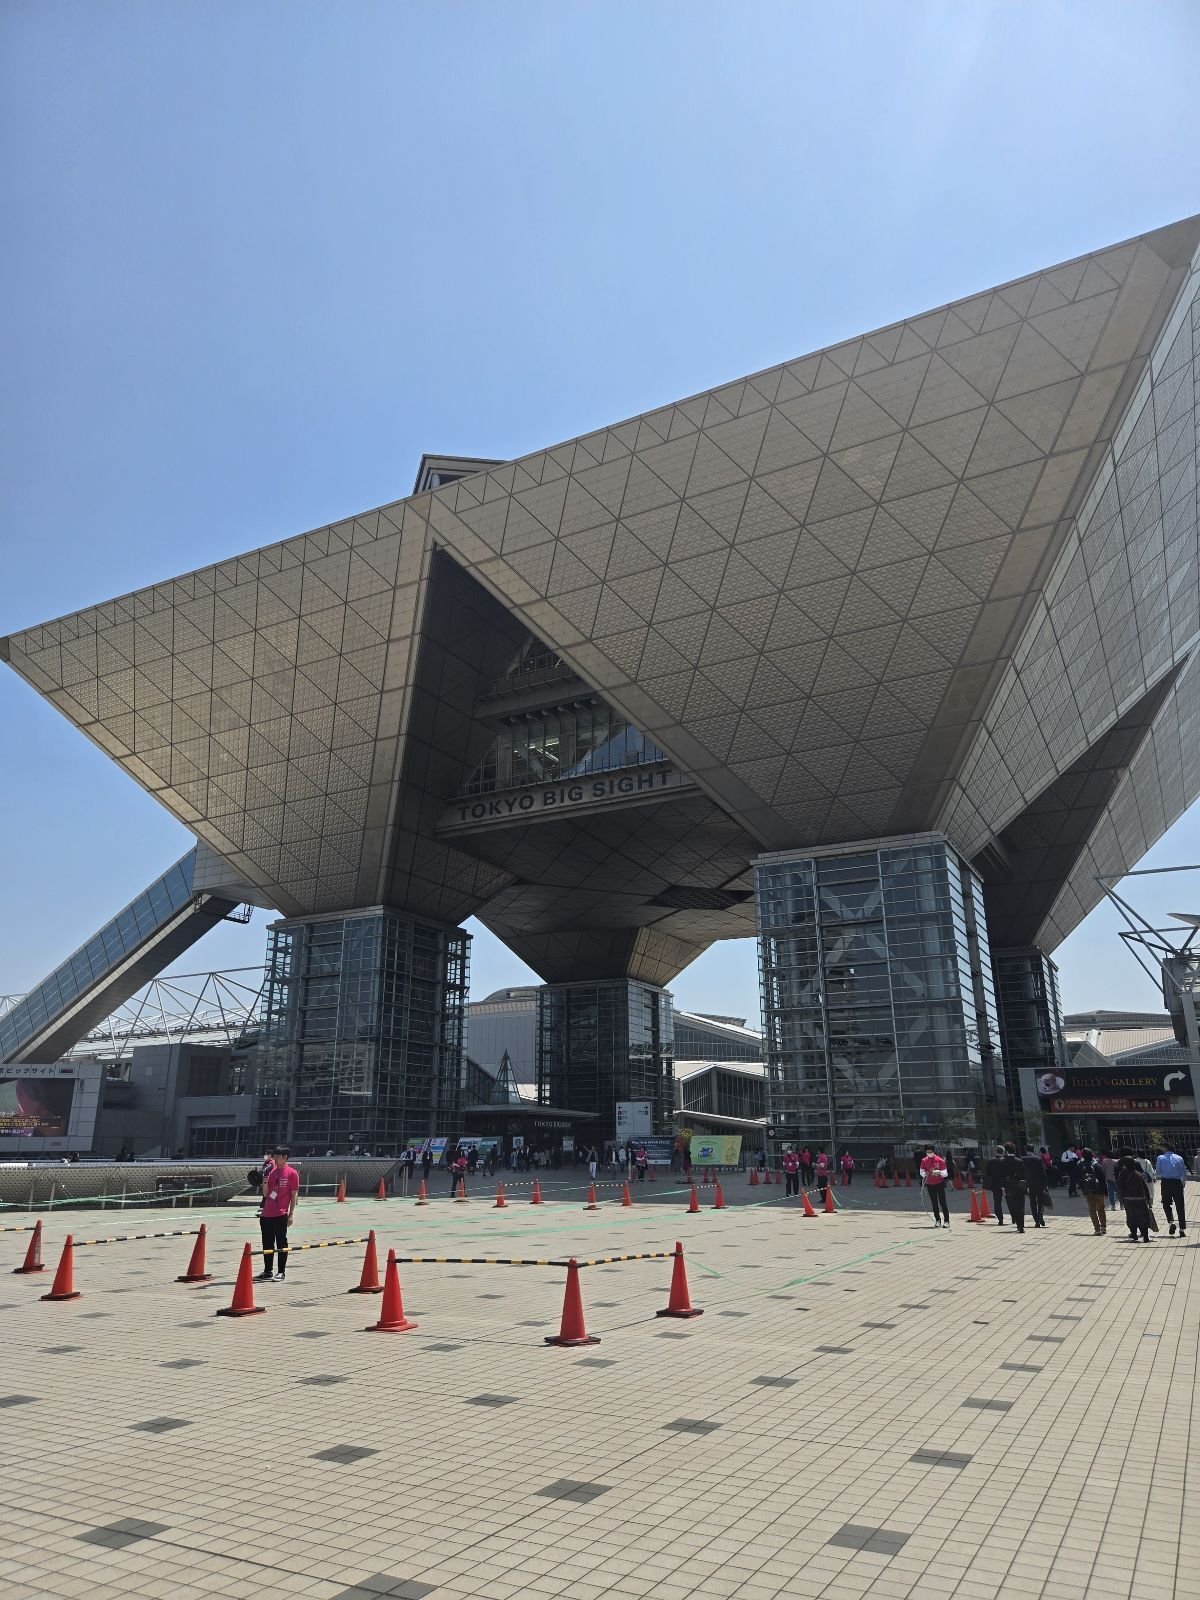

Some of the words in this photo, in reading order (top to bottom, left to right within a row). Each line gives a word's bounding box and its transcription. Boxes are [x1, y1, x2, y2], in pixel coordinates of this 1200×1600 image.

[457, 794, 535, 822] TOKYO
[543, 785, 584, 807] BIG
[591, 769, 673, 798] SIGHT
[1111, 1077, 1158, 1086] GALLERY
